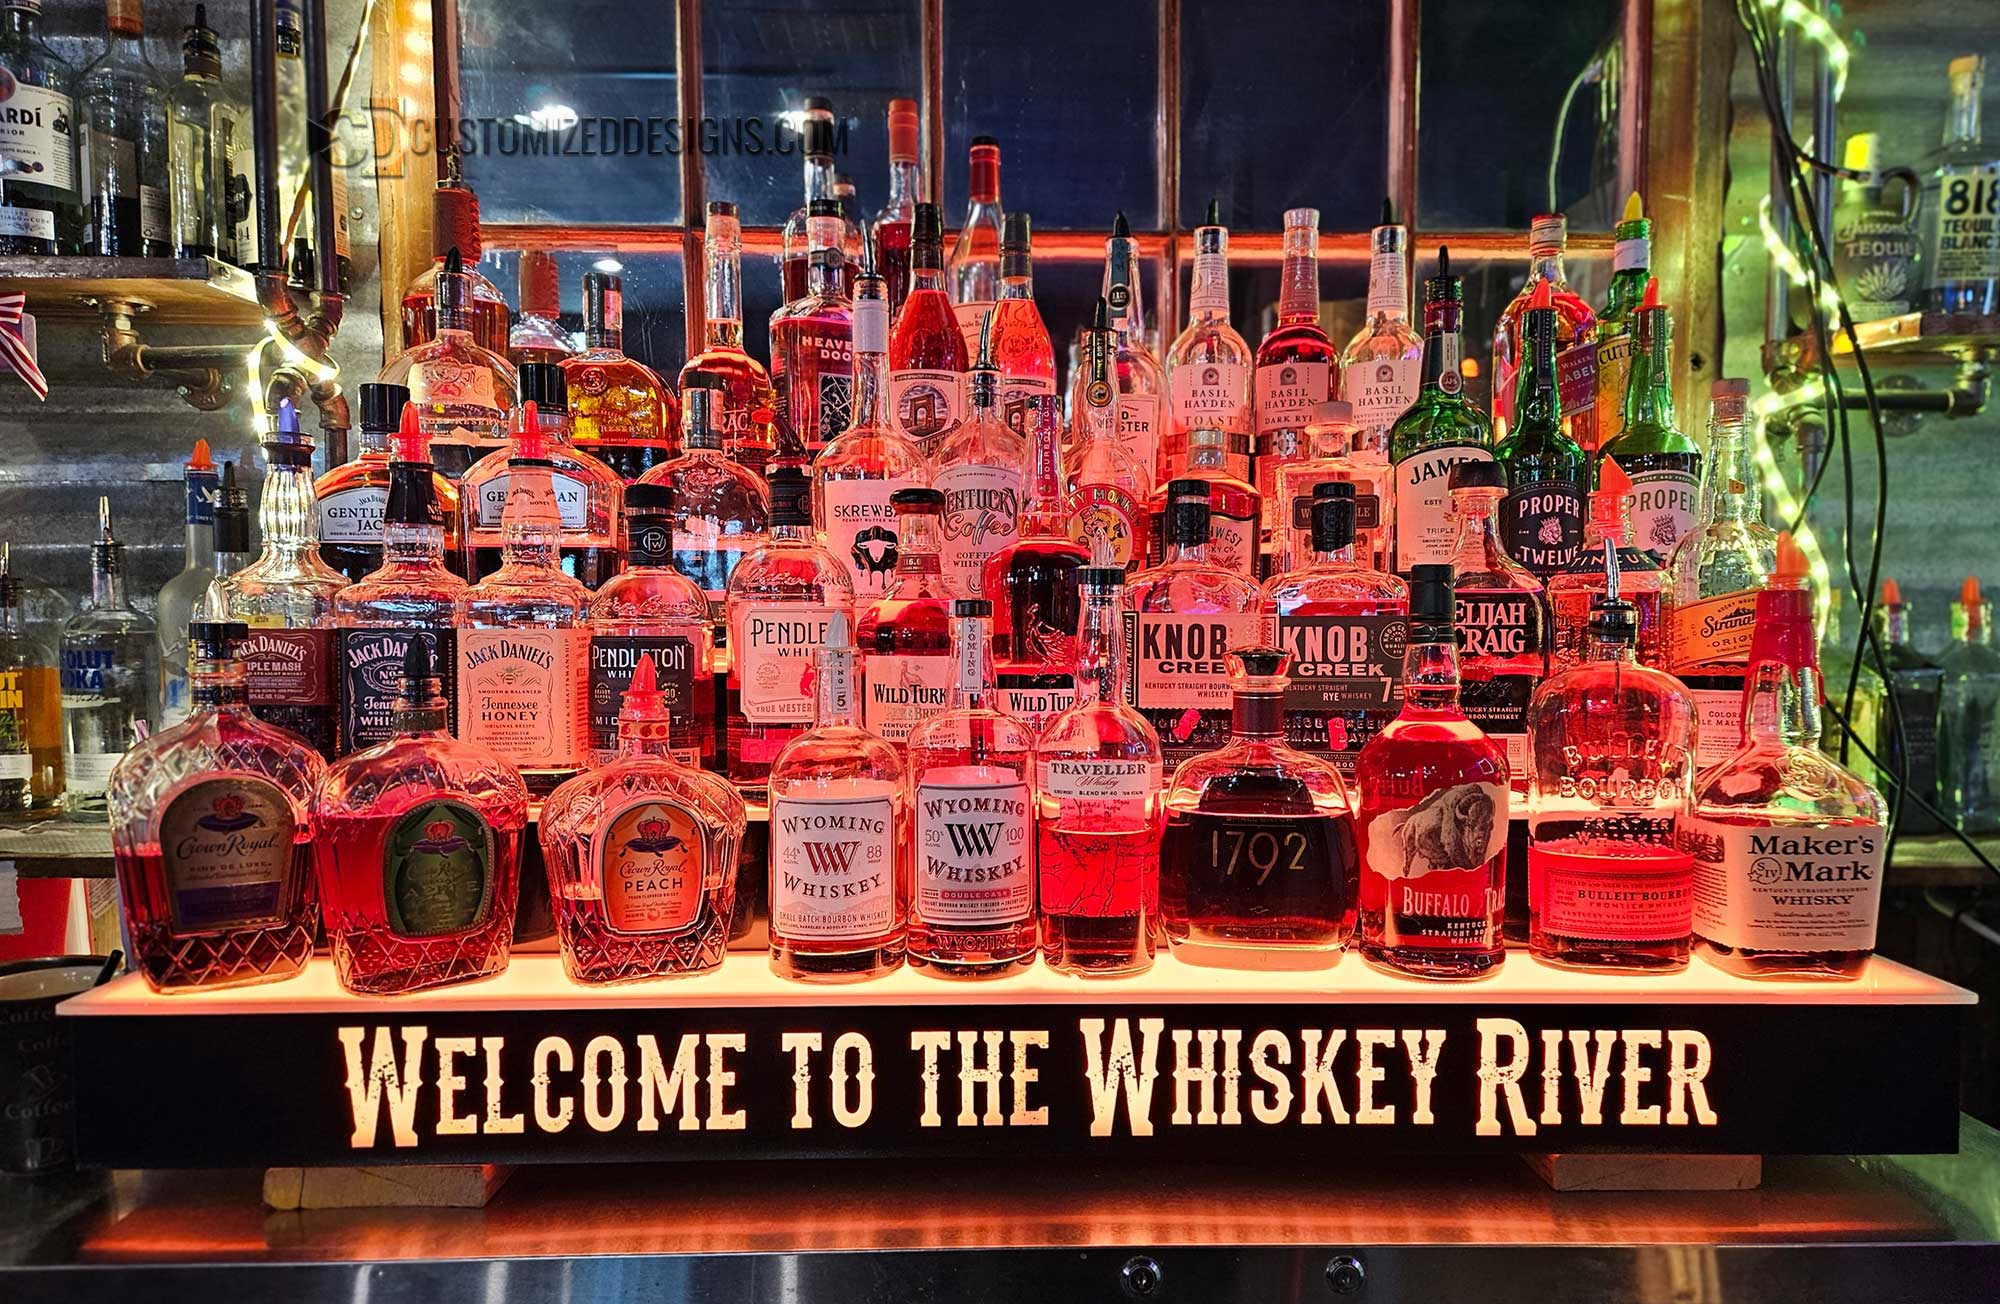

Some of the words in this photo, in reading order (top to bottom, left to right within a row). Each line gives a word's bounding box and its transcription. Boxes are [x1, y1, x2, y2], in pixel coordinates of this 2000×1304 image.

[1946, 179, 2000, 215] 818
[1941, 235, 2000, 250] BLANC
[1112, 291, 1127, 300] 115
[802, 336, 853, 349] HEAVE
[821, 351, 852, 360] DOO
[1599, 342, 1633, 364] CUTT
[1191, 389, 1229, 398] BASIL
[1271, 388, 1309, 399] BASIL
[1365, 385, 1404, 395] BASIL
[1184, 400, 1235, 409] HAYDEN
[1264, 399, 1314, 410] HAYDEN
[1358, 396, 1411, 407] HAYDEN
[1184, 416, 1234, 426] TOAST
[1265, 415, 1290, 424] DARK
[1519, 494, 1580, 518] PROPER
[1629, 489, 1696, 516] PROPER
[328, 507, 385, 518] GENTLE
[358, 519, 382, 531] JAC
[944, 510, 1018, 545] Coffee
[1520, 545, 1579, 566] TWELVE
[1455, 600, 1527, 630] ELIJAH
[750, 618, 828, 647] PENDLE
[1124, 617, 1133, 657] KENTUCKY
[259, 635, 307, 661] DANIEL'S
[1143, 623, 1228, 660] KNOB
[1283, 625, 1368, 662] KNOB
[1455, 625, 1526, 656] CRAIG
[348, 642, 382, 669] JACK
[465, 644, 499, 670] JACK
[500, 640, 554, 670] DANIEL'S
[272, 662, 302, 671] MASH
[1158, 661, 1227, 674] CREE
[1298, 663, 1385, 676] CREEK
[873, 684, 909, 704] WILD
[909, 684, 946, 705] TURK
[1323, 692, 1340, 701] RYE
[1380, 677, 1392, 703] 7
[481, 697, 538, 710] Tennessee
[756, 703, 776, 713] TRUE
[778, 703, 812, 712] WESTER
[837, 694, 846, 707] 5
[1009, 693, 1047, 712] WILD
[482, 711, 539, 721] HONEY
[1051, 762, 1146, 776] TRAVELLER
[1074, 776, 1120, 789] Whiskey
[924, 797, 1025, 819] WYOMING
[781, 815, 884, 835] WYOMING
[1005, 827, 1025, 842] 100
[176, 836, 226, 860] Crown
[219, 832, 279, 857] Royal
[866, 845, 882, 859] 88
[1747, 835, 1875, 856] Maker's
[1212, 829, 1308, 886] 1792
[620, 860, 651, 879] Crown
[644, 859, 687, 877] Royal
[926, 855, 1025, 883] WHISKEY
[1783, 861, 1873, 882] Mark
[624, 877, 683, 893] PEACH
[783, 871, 881, 899] WHISKEY
[943, 891, 980, 899] DOUBLE
[1402, 886, 1470, 918] BUFFALO
[1578, 890, 1635, 900] BULLEIT
[1771, 895, 1855, 905] WHISKY
[1589, 902, 1644, 910] FRONTIER
[798, 914, 820, 923] BATCH
[823, 914, 857, 923] BOURBON
[860, 911, 888, 921] WHISKEY
[1421, 929, 1470, 937] STRAIGHT
[936, 934, 1018, 950] WYOMING
[337, 1025, 747, 1149] WELCOME
[781, 1031, 876, 1130] TO
[911, 1030, 1050, 1128] THE
[1078, 1017, 1448, 1138] WHISKEY
[1475, 1017, 1718, 1137] RIVER
